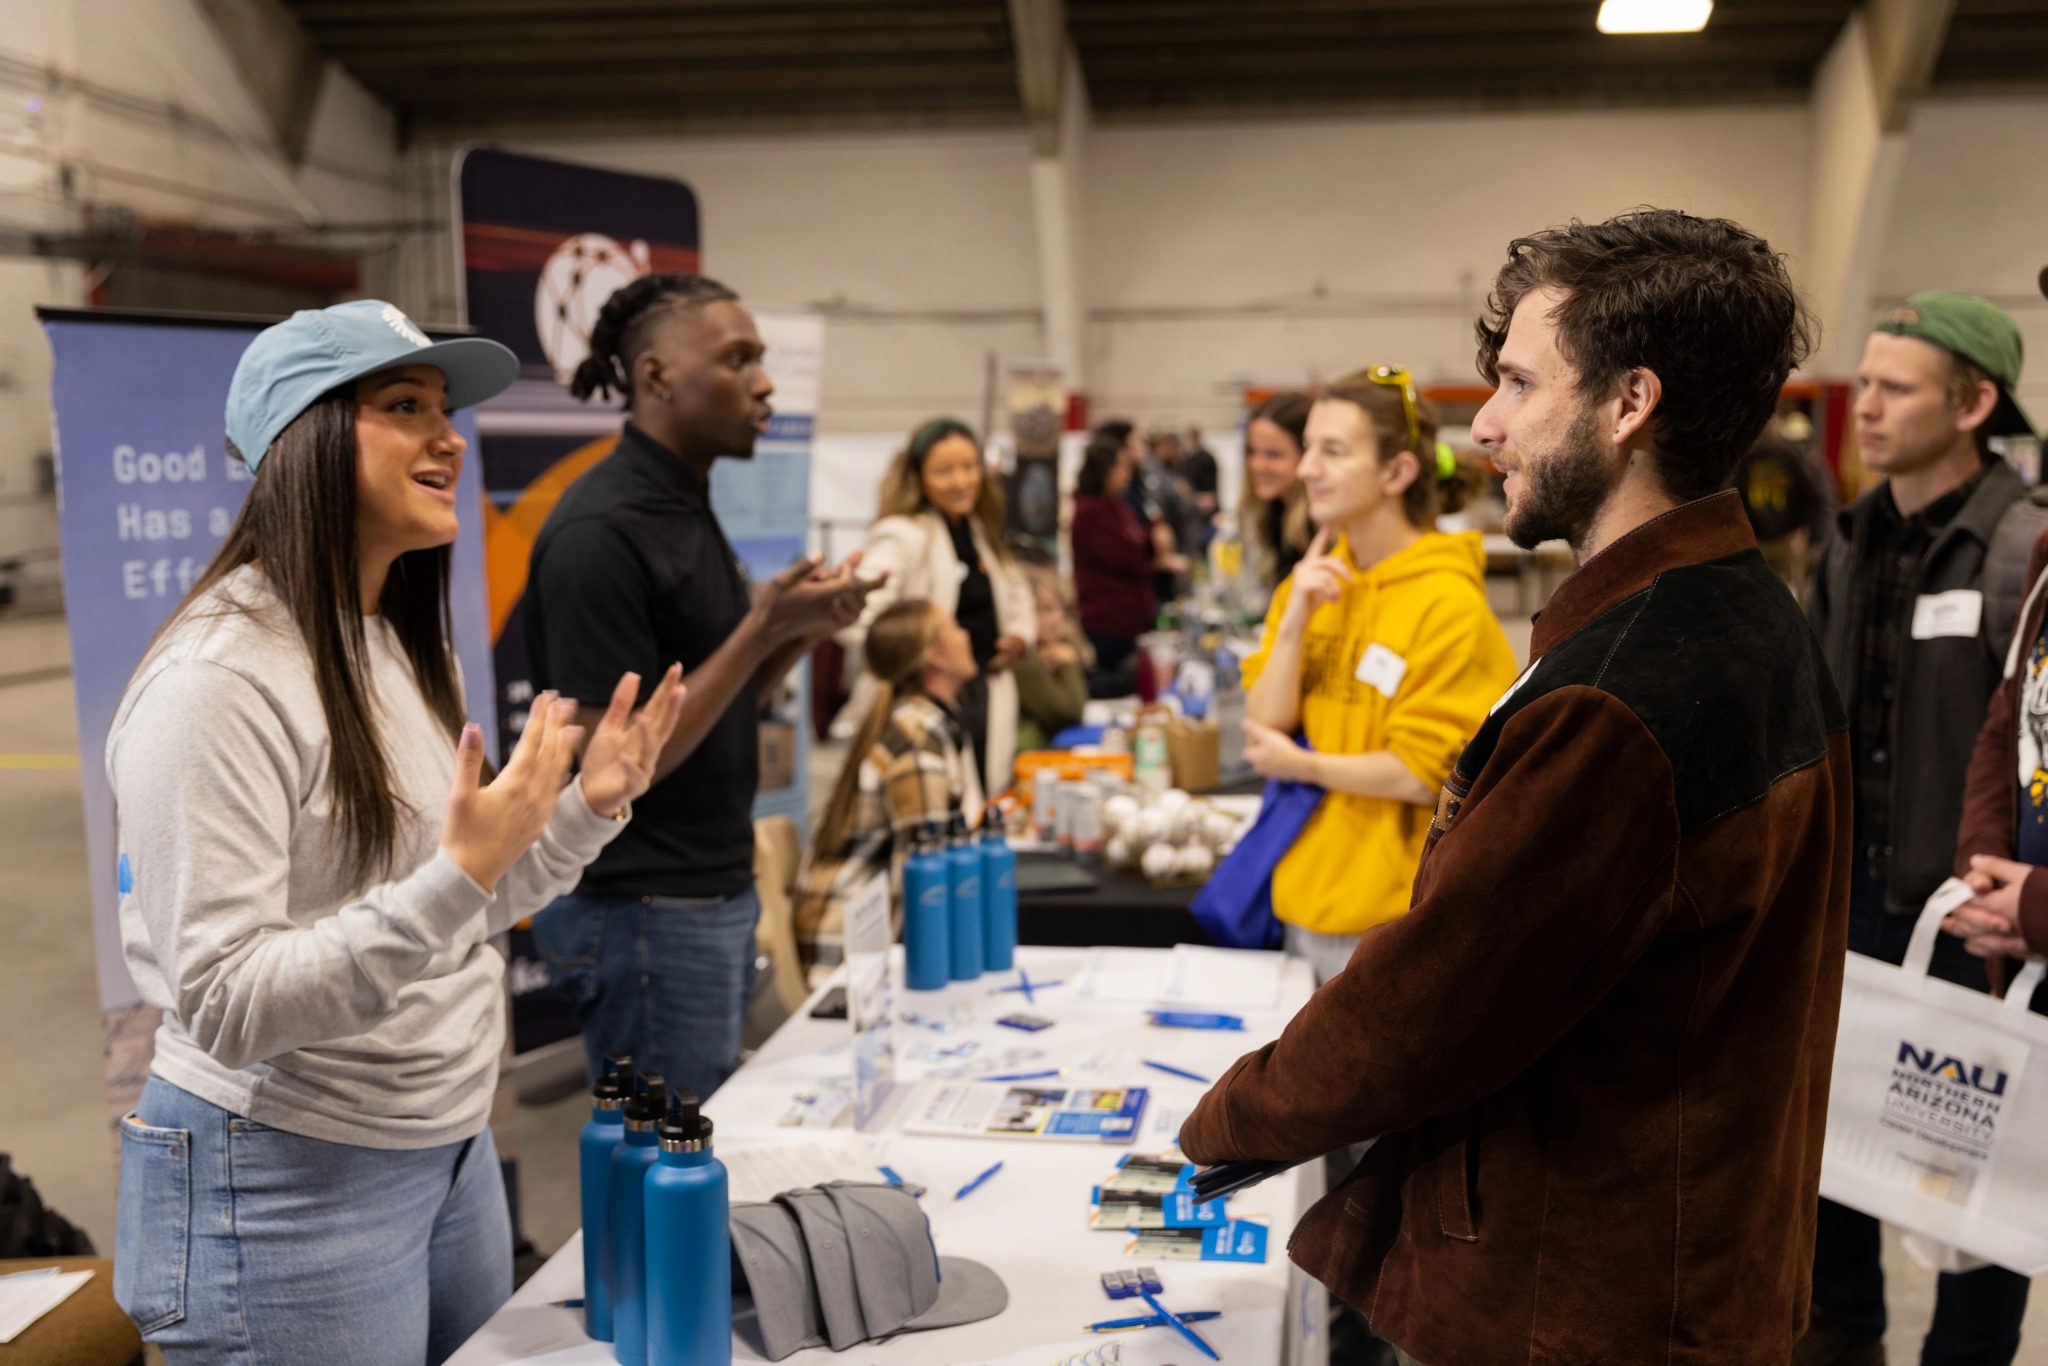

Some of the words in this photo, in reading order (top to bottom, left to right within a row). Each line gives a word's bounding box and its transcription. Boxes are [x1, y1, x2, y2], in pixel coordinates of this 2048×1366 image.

[113, 444, 207, 484] Good
[117, 503, 192, 542] Has
[122, 557, 206, 599] Eff
[1892, 1068, 2001, 1114] NORTHERN
[1898, 1041, 2008, 1096] NAU
[1885, 1096, 1994, 1141] UNIVERSITY
[1889, 1081, 1995, 1130] ARIZONA
